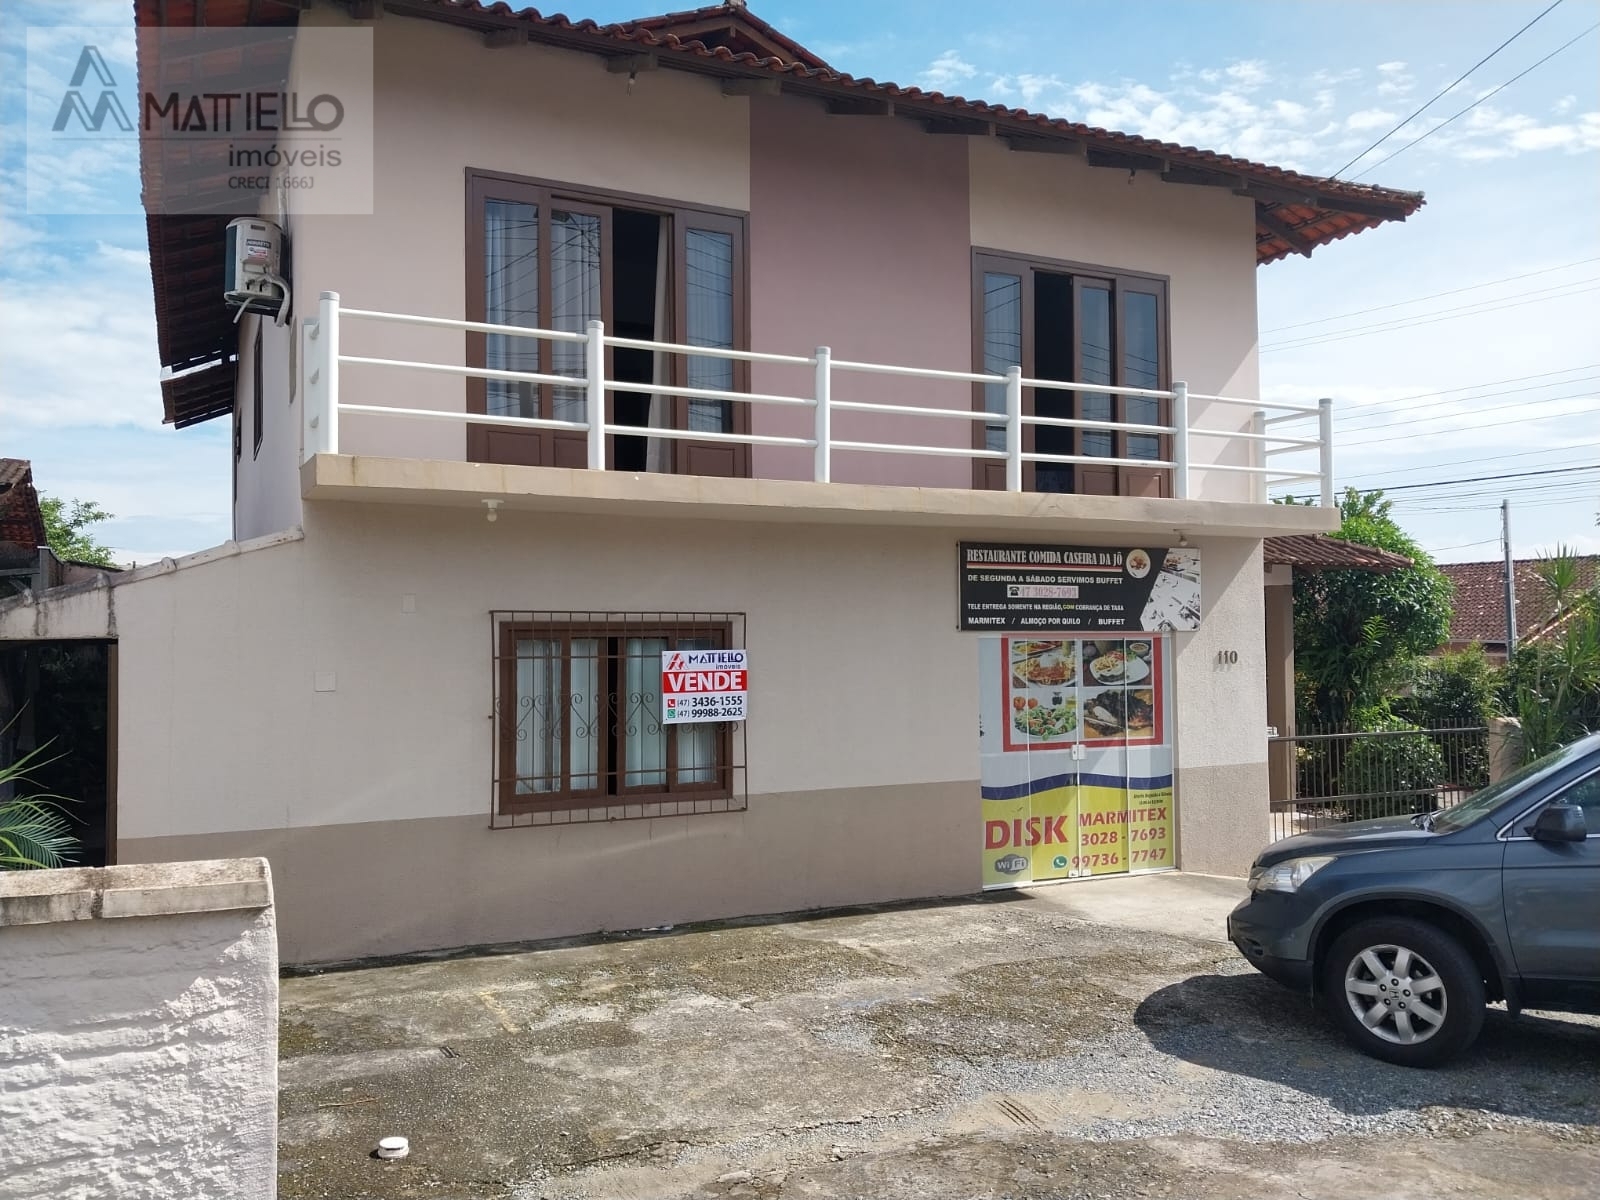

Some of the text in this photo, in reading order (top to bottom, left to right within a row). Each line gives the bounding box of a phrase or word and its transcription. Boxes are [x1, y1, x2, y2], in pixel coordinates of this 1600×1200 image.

[966, 549, 1027, 563] RESTAURANTE
[1028, 551, 1062, 564] COMIDA
[1063, 552, 1098, 565] CASEIRA
[1099, 553, 1111, 565] DA
[967, 574, 978, 582] DE
[979, 574, 1017, 583] SEGUNDA
[1018, 575, 1025, 583] A
[1025, 573, 1056, 584] SÁBADO
[1057, 576, 1095, 585] SERVIMOS
[968, 617, 1006, 625] MARMITEX
[1020, 617, 1047, 626] ALMOÇO
[1098, 618, 1125, 626] BUFFET
[688, 652, 744, 664] MATTIELLO
[1218, 650, 1238, 665] 110
[667, 671, 743, 692] VENDE
[691, 695, 743, 707] 3436-1555
[691, 707, 743, 719] 99988-2625
[1079, 807, 1168, 827] MARMITEX
[984, 815, 1069, 850] DISK
[1080, 831, 1118, 846] 3028
[1130, 827, 1167, 842] 7693
[1071, 852, 1119, 869] 99736
[1131, 847, 1167, 863] 7747
